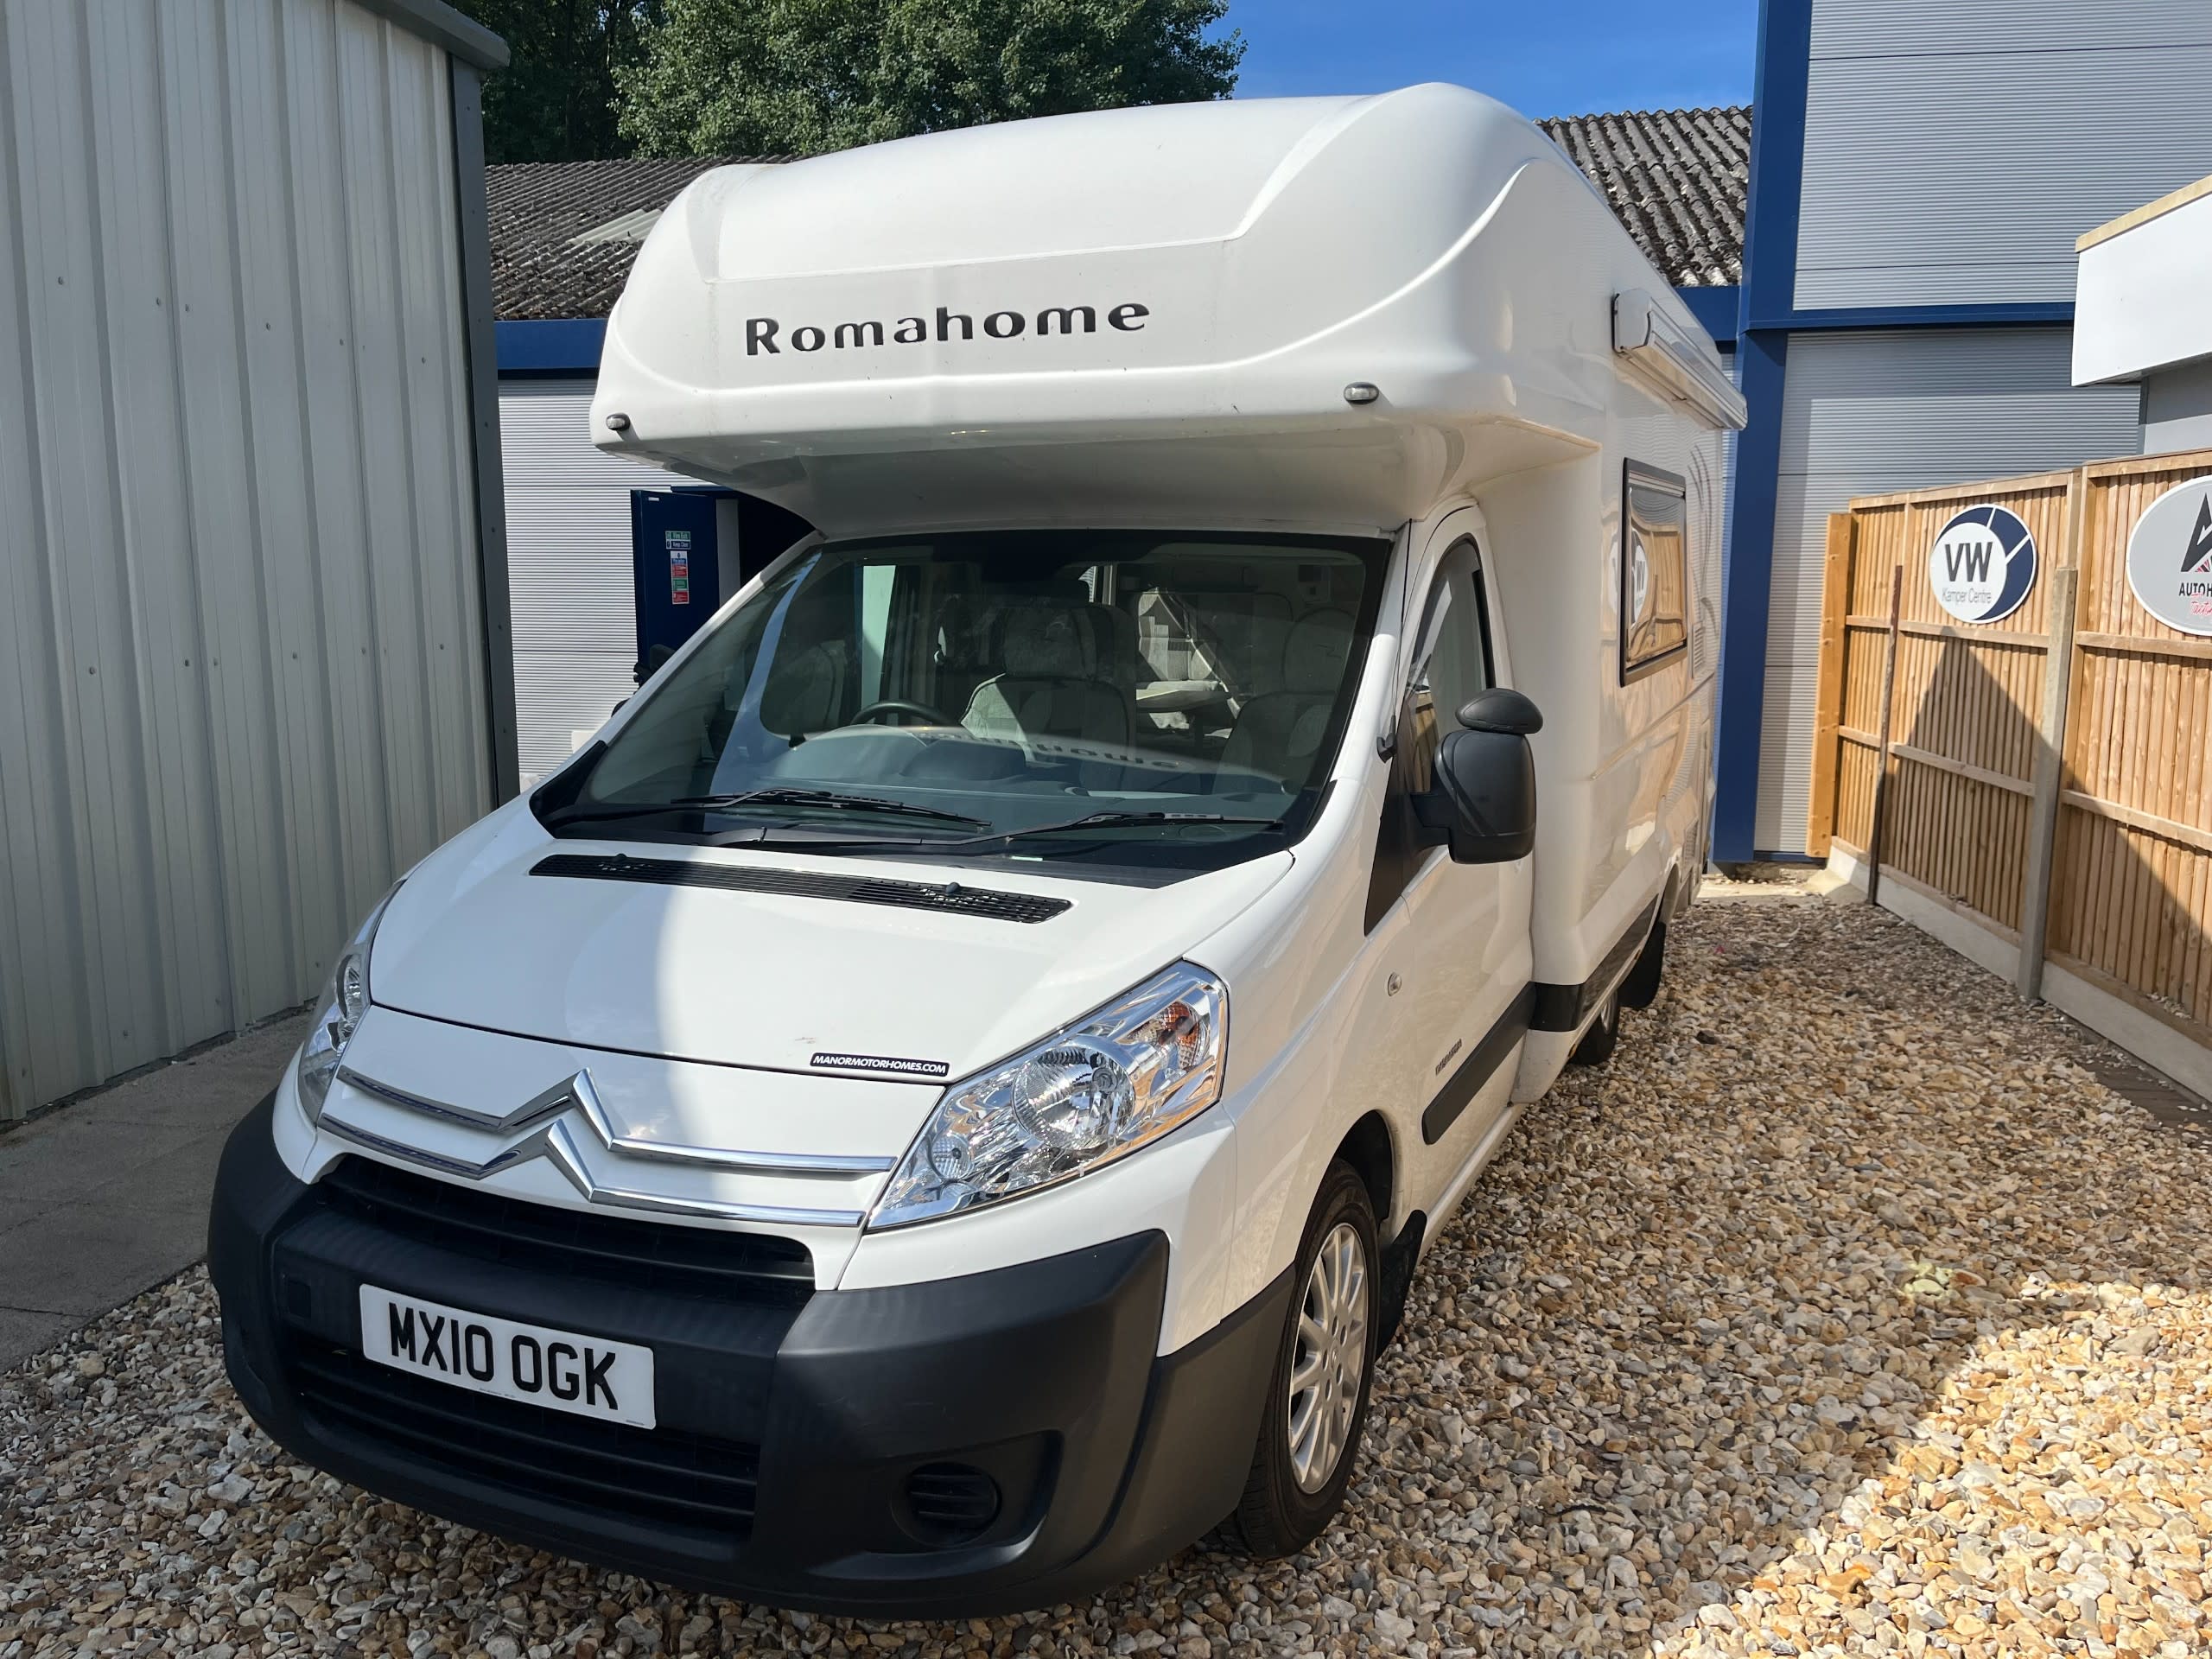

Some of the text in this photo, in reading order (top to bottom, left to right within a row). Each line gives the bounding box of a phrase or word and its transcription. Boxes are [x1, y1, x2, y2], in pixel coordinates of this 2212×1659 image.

[745, 302, 1150, 356] Romahome
[1944, 541, 1993, 582] VW
[1942, 588, 1992, 606] Kamper Centre
[812, 1055, 947, 1074] MANORMOTORHOMES.COM
[388, 1301, 619, 1411] MX10 OGK
